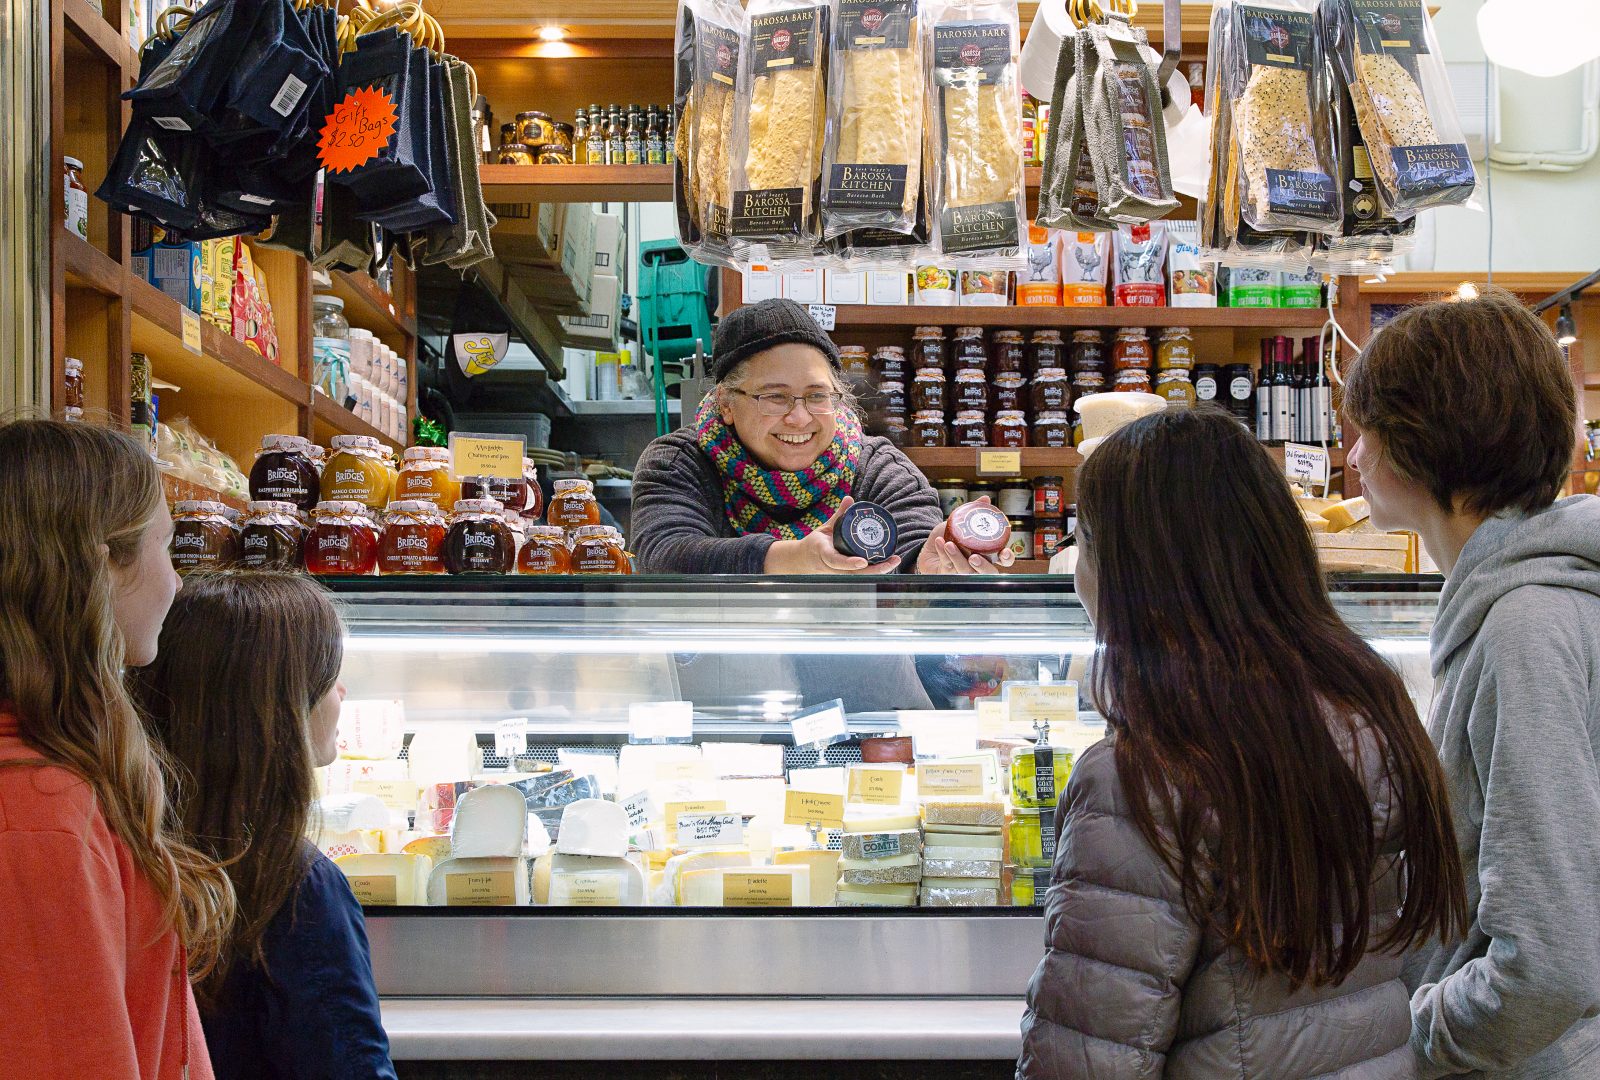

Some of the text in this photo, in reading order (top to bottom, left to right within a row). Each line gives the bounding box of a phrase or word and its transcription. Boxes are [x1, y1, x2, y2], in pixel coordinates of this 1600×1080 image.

[1356, 0, 1421, 8] BAROSSA BARK
[753, 11, 813, 27] BAROSSA BARK
[1246, 12, 1310, 25] BAROSSA BARK
[702, 23, 732, 41] BAROSSA
[937, 28, 1007, 39] BAROSSA BARK
[335, 103, 368, 126] Gift
[358, 117, 388, 139] Bags
[327, 127, 364, 148] $2.50
[1405, 149, 1457, 163] BAROSSA
[1408, 160, 1460, 169] KITCHEN
[843, 166, 892, 181] BAROSSA
[841, 180, 893, 191] KITCHEN
[1278, 174, 1325, 191] BAROSSA
[745, 193, 790, 208] BAROSSA
[1280, 188, 1327, 202] KITCHEN
[744, 207, 791, 217] KITCHEN
[953, 210, 1003, 225] BAROSSA
[953, 221, 1004, 234] KITCHEN
[1126, 295, 1137, 304] BEEF
[267, 470, 297, 481] BRIDGES
[335, 471, 364, 482] BRIDGES
[407, 477, 432, 488] BRIDGES
[564, 502, 584, 510] BRIDGES
[175, 535, 205, 547] BRIDGES
[244, 536, 268, 548] BRIDGES
[319, 537, 348, 549] BRIDGES
[397, 537, 428, 549] BRIDGES
[465, 534, 495, 546] BRIDGES
[531, 549, 551, 558] BRIDGES
[587, 548, 608, 557] BRIDGES
[722, 817, 734, 825] Goat
